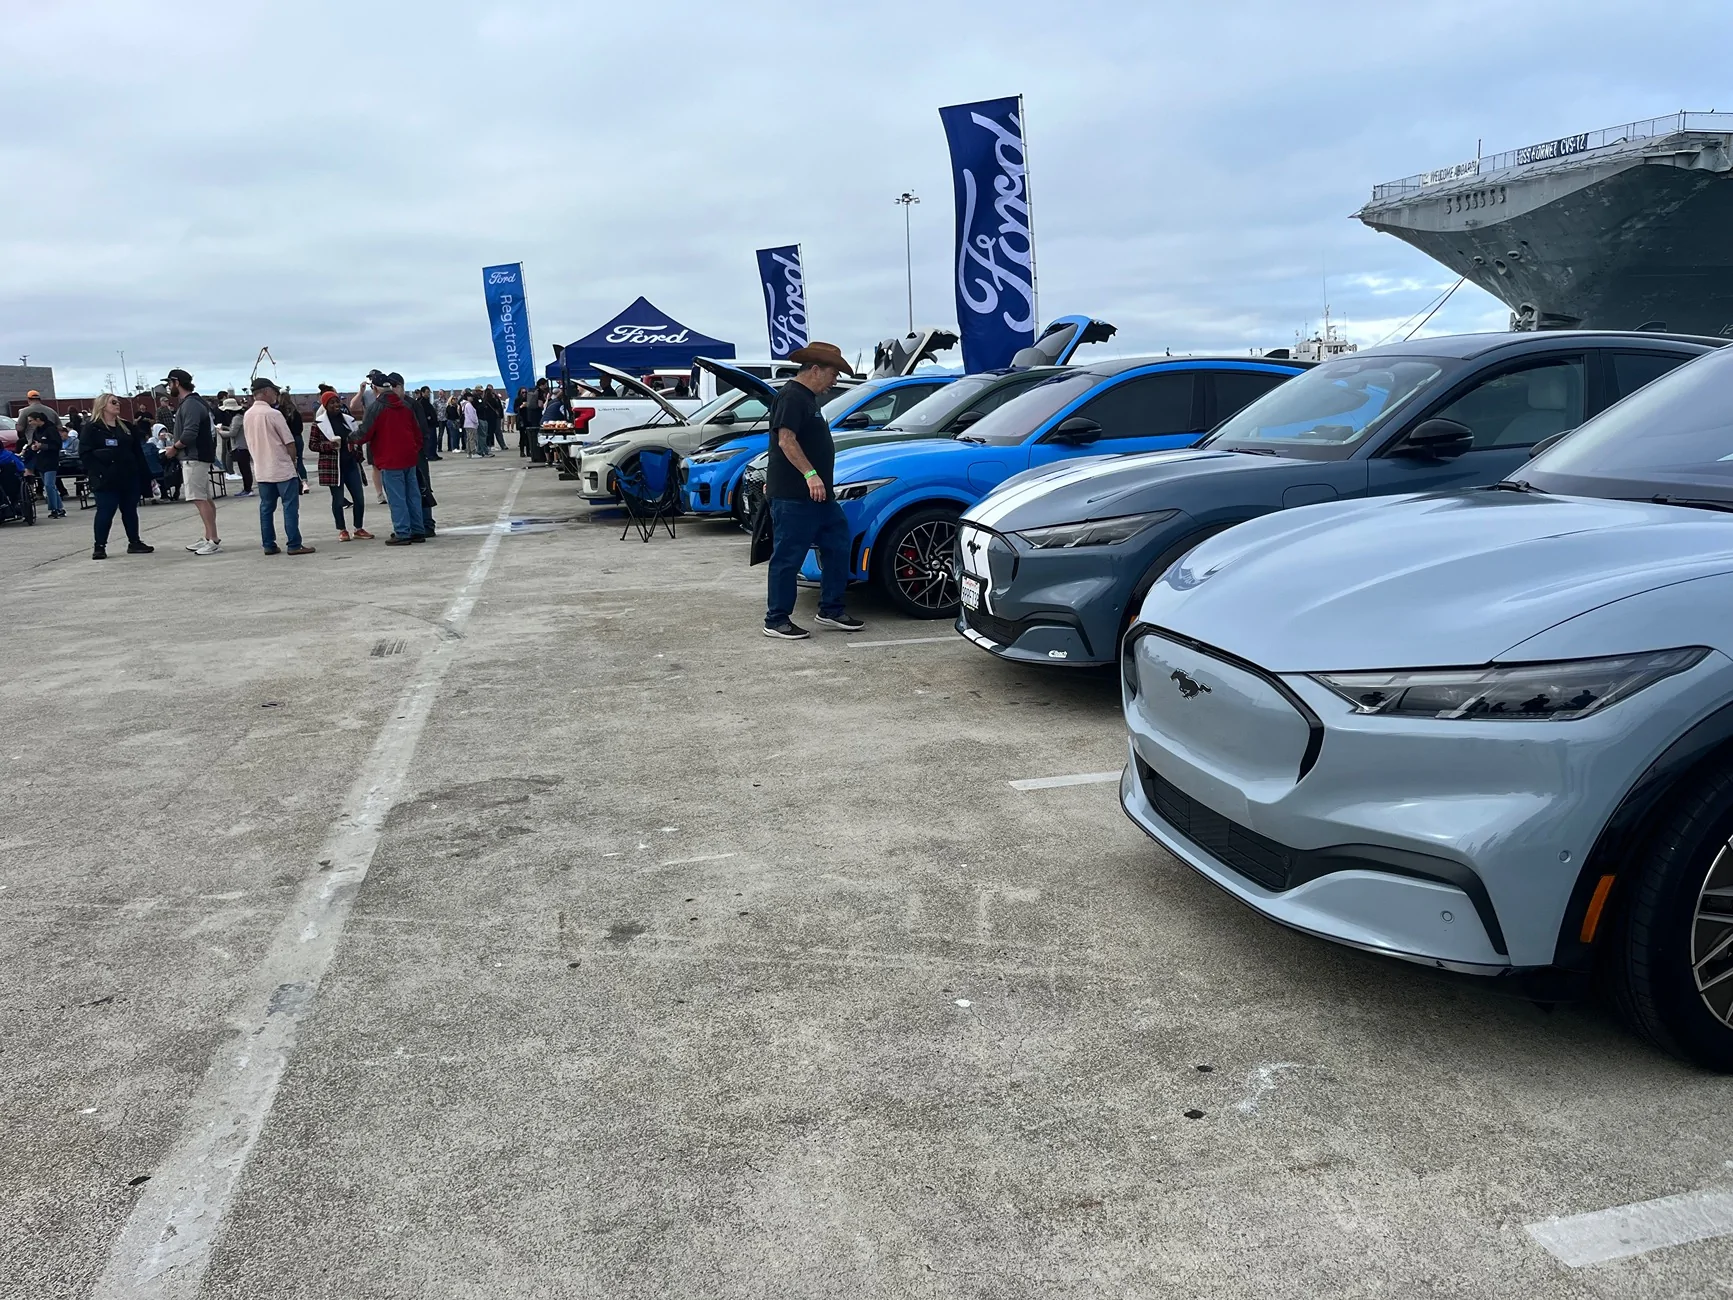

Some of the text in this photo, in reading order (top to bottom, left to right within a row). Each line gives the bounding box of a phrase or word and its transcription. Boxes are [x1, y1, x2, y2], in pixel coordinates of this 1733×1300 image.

[1561, 134, 1585, 155] CVS-12
[959, 112, 1034, 332] Ford
[488, 271, 516, 285] Ford
[766, 252, 808, 356] Ford
[500, 294, 521, 381] Registration
[605, 325, 689, 344] Ford
